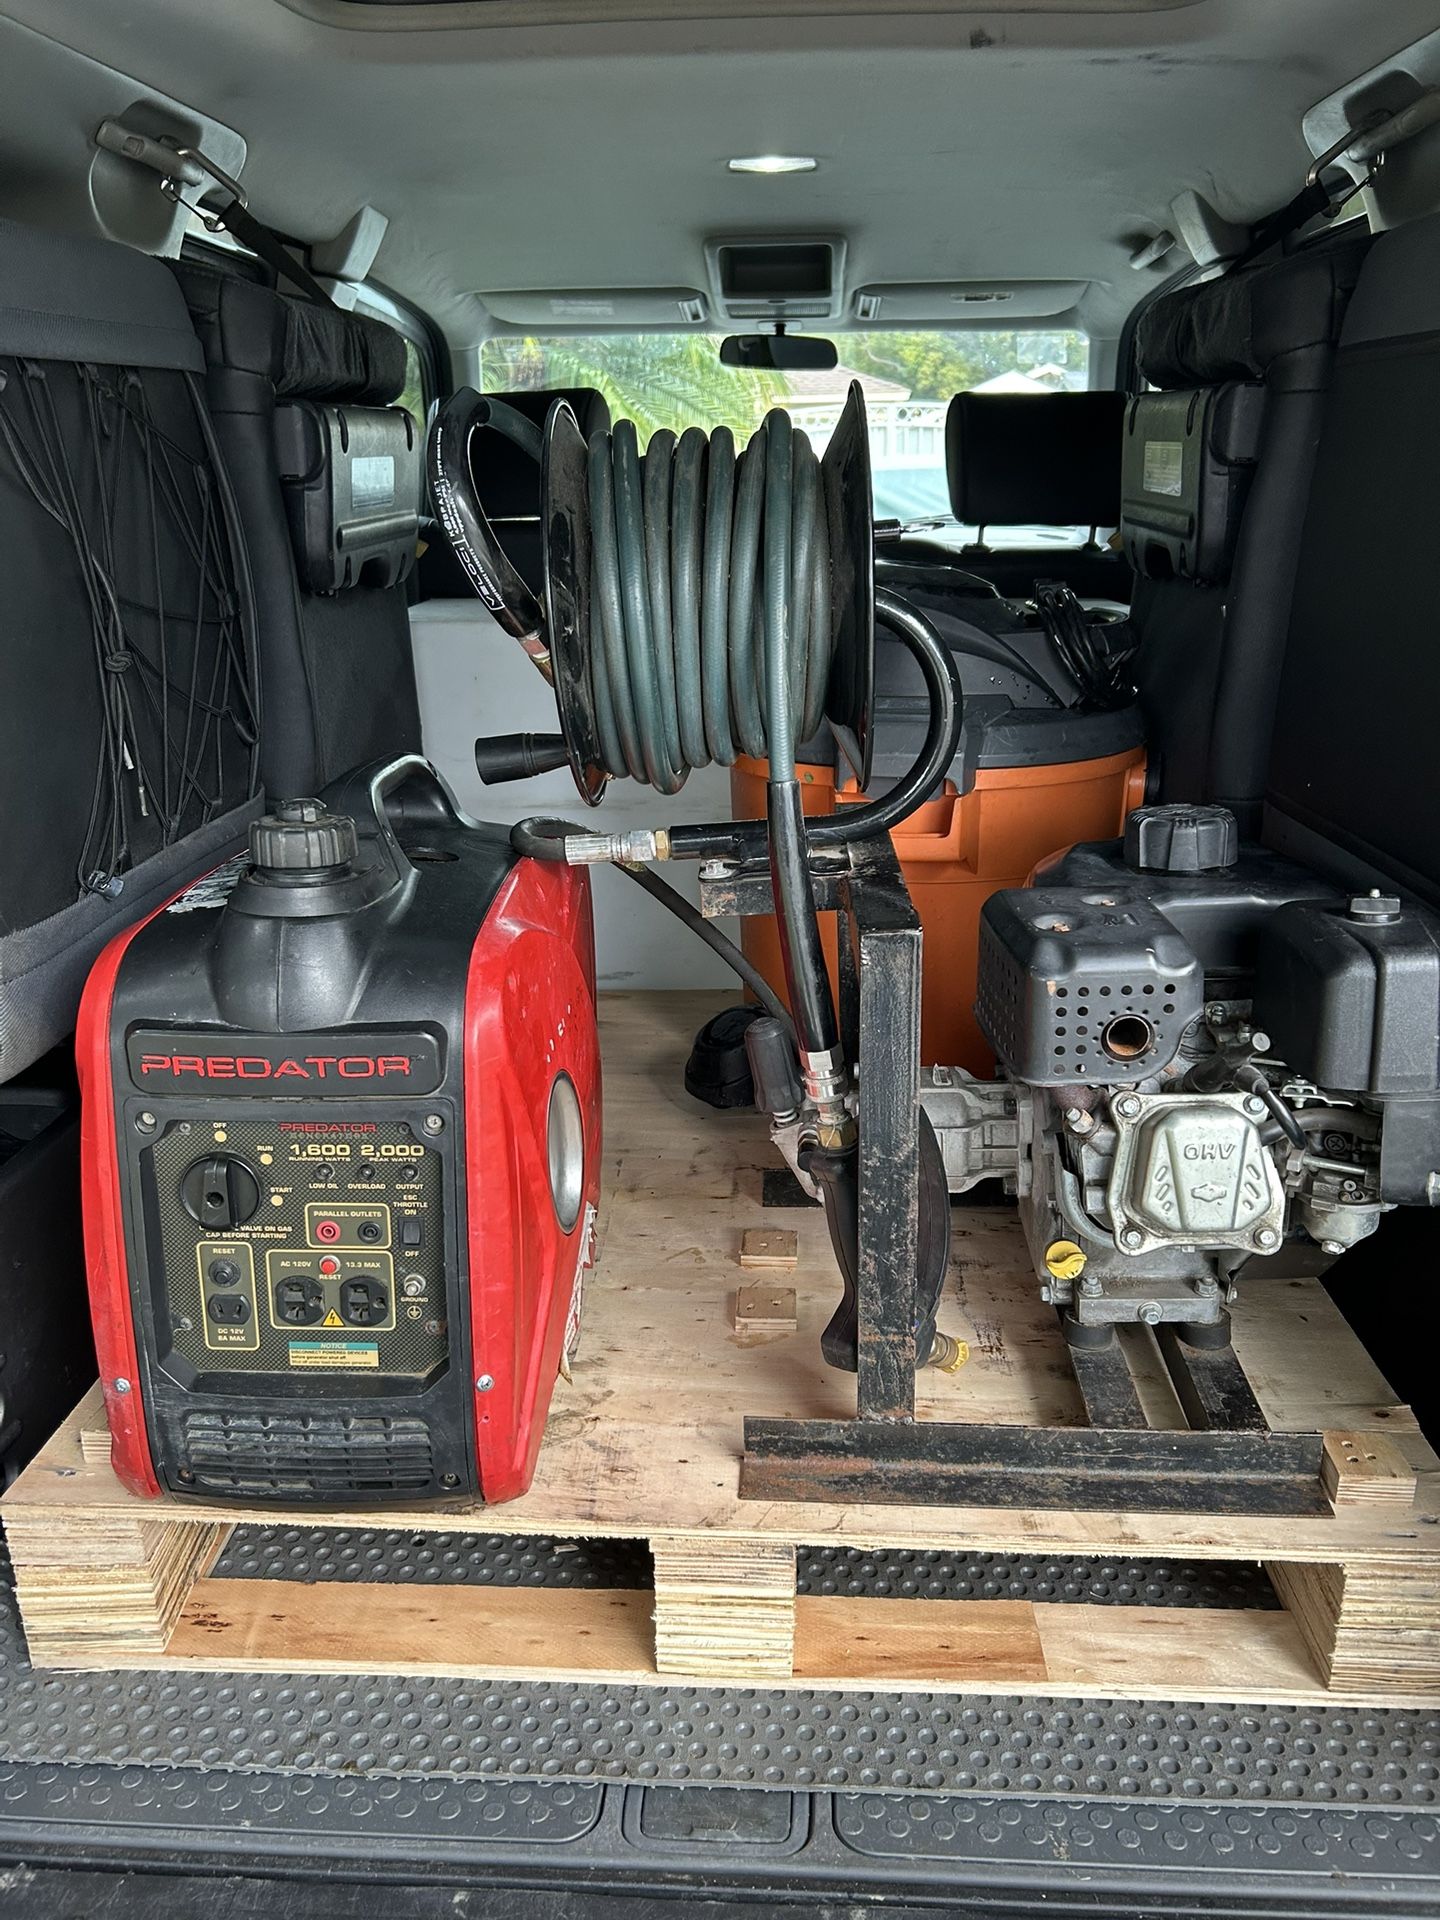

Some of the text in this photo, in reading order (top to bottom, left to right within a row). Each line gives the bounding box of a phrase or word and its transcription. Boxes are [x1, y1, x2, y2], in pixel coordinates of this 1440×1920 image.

[459, 547, 494, 606] VELOCI
[141, 1055, 411, 1078] PREDATOR
[280, 1123, 376, 1132] PREDATOR
[290, 1144, 424, 1158] 1,600 2,000
[1184, 1143, 1236, 1160] OHV
